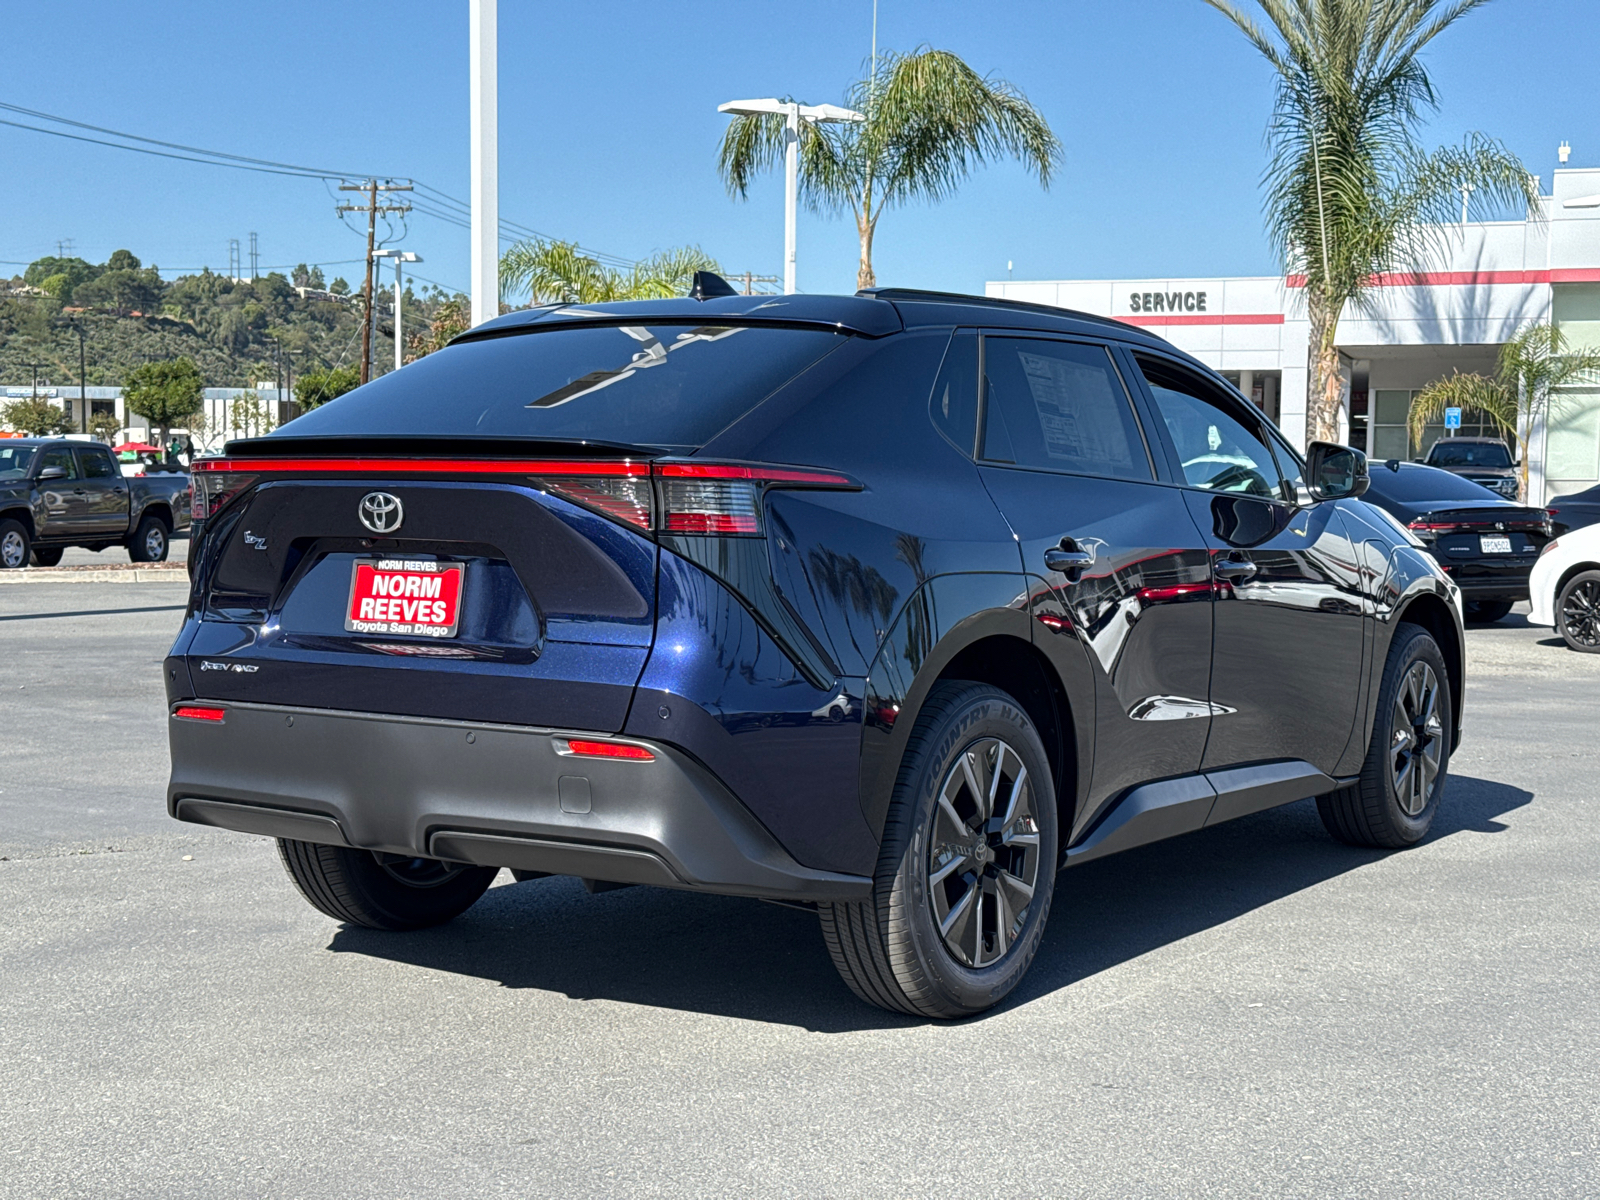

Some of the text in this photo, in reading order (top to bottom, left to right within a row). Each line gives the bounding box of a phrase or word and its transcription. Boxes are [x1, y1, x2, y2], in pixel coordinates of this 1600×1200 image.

[1129, 291, 1207, 313] SERVICE
[378, 560, 437, 571] NORM REEVES
[371, 574, 442, 598] NORM
[359, 597, 447, 623] REEVES
[351, 620, 448, 637] Toyota San Diego
[925, 703, 991, 799] COUNTRY
[1000, 705, 1029, 731] H/T
